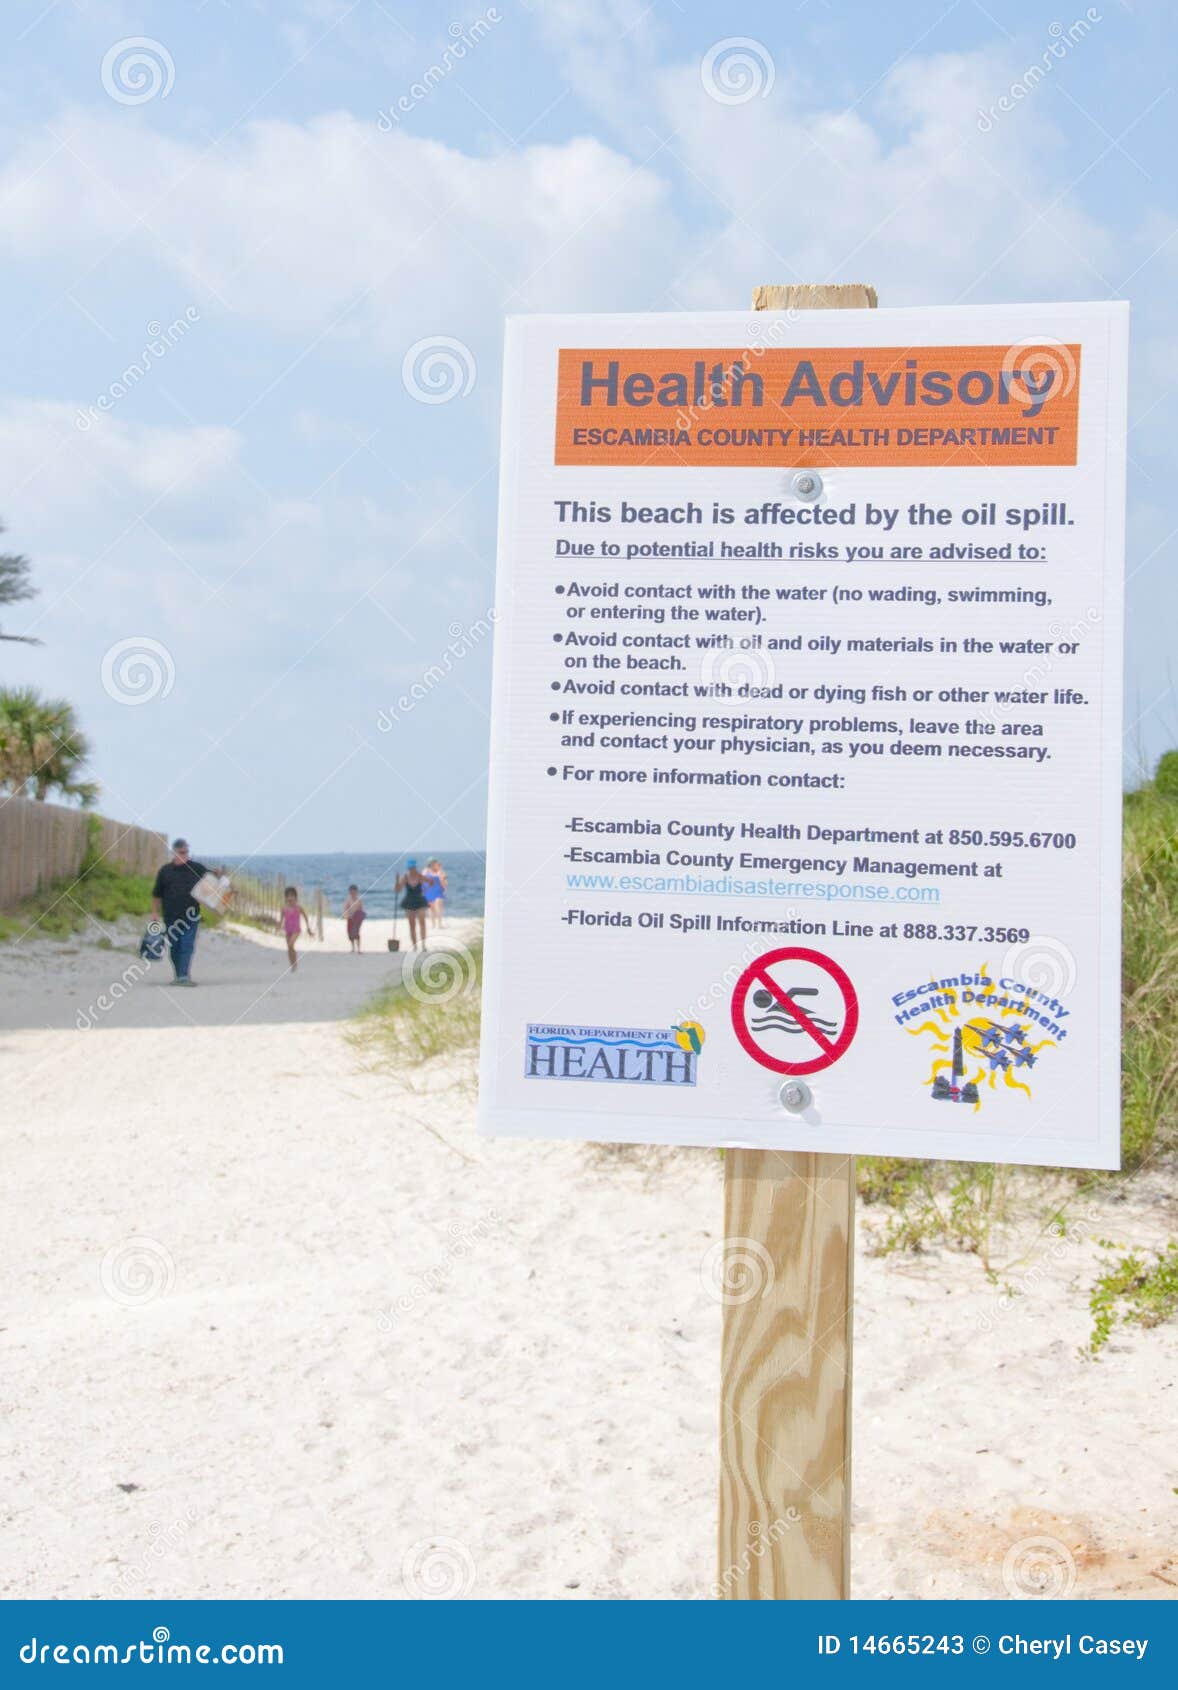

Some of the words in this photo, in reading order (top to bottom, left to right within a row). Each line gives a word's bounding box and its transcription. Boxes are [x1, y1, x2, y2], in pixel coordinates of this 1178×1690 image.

[581, 361, 764, 407] Health
[781, 361, 1056, 418] Advisory
[573, 428, 692, 446] ESCAMBIA
[698, 429, 792, 446] COUNTY
[799, 429, 889, 446] HEALTH
[897, 427, 1058, 446] DEPARTMENT
[554, 501, 611, 522] This
[621, 502, 702, 523] beach
[713, 503, 735, 524] is
[744, 500, 855, 525] affected
[866, 504, 899, 530] by
[908, 504, 952, 525] the
[962, 503, 996, 525] oil
[1006, 503, 1074, 530] spill.
[556, 540, 595, 556] Due
[600, 540, 621, 557] to
[626, 541, 714, 560] potential
[720, 542, 783, 558] health
[789, 543, 839, 559] risks
[845, 547, 884, 563] you
[890, 547, 923, 559] are
[929, 543, 1012, 560] advised
[1018, 545, 1047, 560] to:
[567, 582, 618, 597] Avoid
[625, 585, 692, 598] contact
[698, 584, 735, 599] with
[742, 585, 770, 599] the
[776, 587, 827, 600] water
[833, 586, 862, 604] (no
[868, 587, 941, 605] wading,
[948, 587, 1052, 606] swimming,
[567, 607, 585, 618] or
[591, 605, 665, 623] entering
[671, 605, 699, 620] the
[705, 606, 766, 625] water).
[565, 632, 617, 646] Avoid
[623, 634, 690, 648] contact
[696, 634, 733, 649] with
[740, 635, 762, 649] oil
[768, 636, 802, 650] and
[808, 636, 841, 654] oily
[848, 637, 933, 652] materials
[941, 638, 957, 652] in
[963, 638, 993, 653] the
[999, 640, 1053, 654] water
[1059, 643, 1080, 654] or
[565, 657, 587, 668] on
[593, 654, 620, 668] the
[627, 655, 686, 670] beach.
[563, 679, 615, 694] Avoid
[620, 682, 688, 696] contact
[694, 683, 732, 697] with
[738, 683, 782, 698] dead
[789, 688, 808, 699] or
[814, 685, 865, 704] dying
[872, 686, 906, 701] fish
[913, 690, 933, 701] or
[939, 687, 989, 702] other
[994, 690, 1048, 703] water
[1054, 689, 1088, 704] life.
[562, 710, 574, 724] If
[579, 712, 696, 731] experiencing
[703, 715, 803, 734] respiratory
[810, 717, 903, 735] problems,
[910, 718, 959, 734] leave
[965, 720, 995, 735] the
[1002, 724, 1043, 736] area
[561, 734, 594, 747] and
[600, 735, 668, 749] contact
[674, 739, 716, 753] your
[721, 737, 815, 755] physician,
[822, 742, 843, 753] as
[849, 743, 883, 758] you
[890, 740, 941, 756] deem
[949, 745, 1051, 762] necessary.
[563, 765, 594, 781] For
[600, 770, 647, 782] more
[653, 768, 761, 786] information
[768, 773, 844, 788] contact:
[565, 818, 661, 835] -Escambia
[668, 821, 735, 841] County
[741, 823, 800, 839] Health
[808, 825, 919, 844] Department
[925, 830, 943, 844] at
[949, 830, 1076, 849] 850.595.6700
[564, 847, 660, 864] -Escambia
[666, 851, 734, 871] County
[740, 853, 847, 875] Emergency
[853, 857, 978, 878] Management
[984, 863, 1002, 877] at
[566, 871, 940, 903] www.escambiadisasterresponse.com
[562, 910, 632, 927] -Florida
[638, 913, 664, 928] Oil
[670, 914, 711, 933] Spill
[717, 916, 826, 935] Information
[833, 921, 873, 936] Line
[880, 924, 898, 938] at
[904, 924, 1030, 943] 888.337.3569
[891, 973, 993, 1007] Escambia
[1000, 978, 1070, 1019] County
[894, 992, 957, 1025] Health
[961, 991, 1067, 1041] Department
[529, 1026, 576, 1036] FLORIDA
[579, 1029, 652, 1039] DEPARTMENT
[655, 1032, 672, 1040] OF
[527, 1044, 696, 1083] HEALTH
